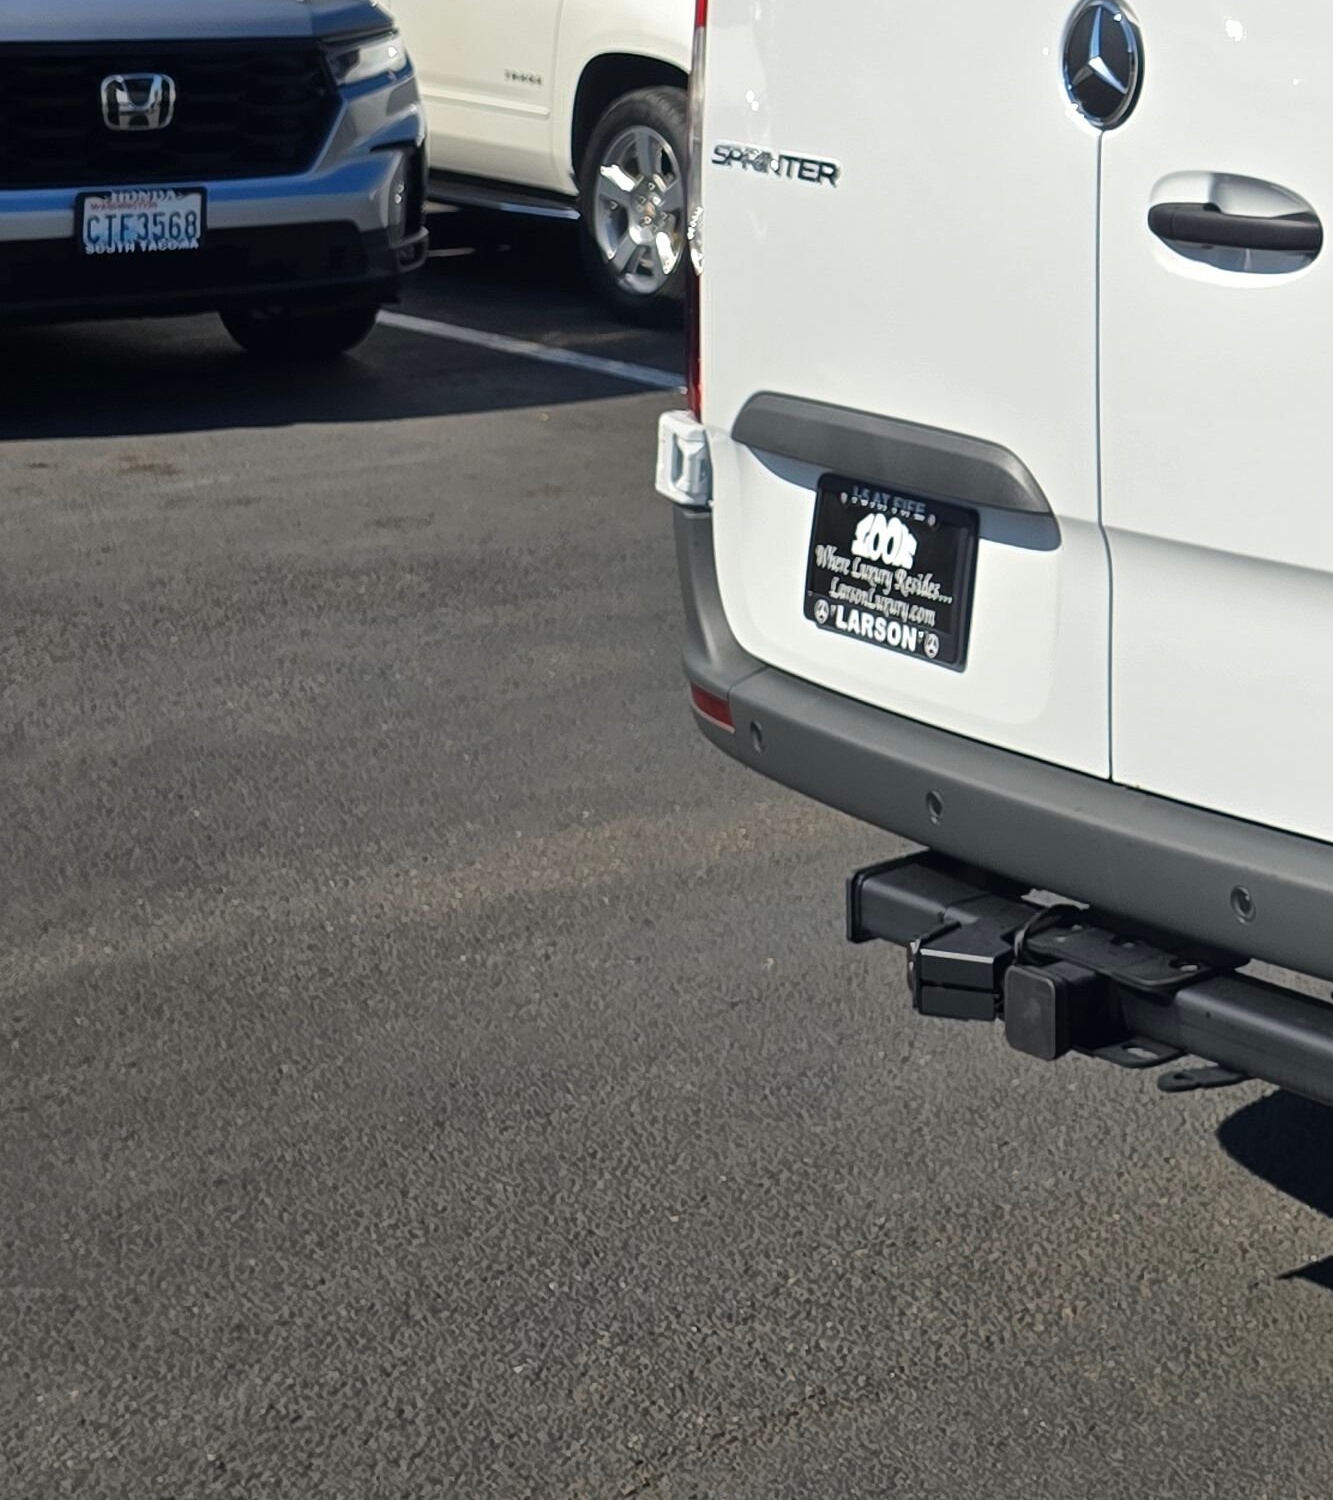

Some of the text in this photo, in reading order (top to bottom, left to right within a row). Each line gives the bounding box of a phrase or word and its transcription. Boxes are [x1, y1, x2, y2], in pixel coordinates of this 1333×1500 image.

[712, 144, 838, 188] SPRINTER
[85, 238, 199, 255] SOUTH TACOMA
[87, 210, 197, 243] CTF3568
[814, 544, 851, 577] Where
[851, 556, 894, 596] Luxury
[829, 576, 936, 627] LarsonLuxury.com
